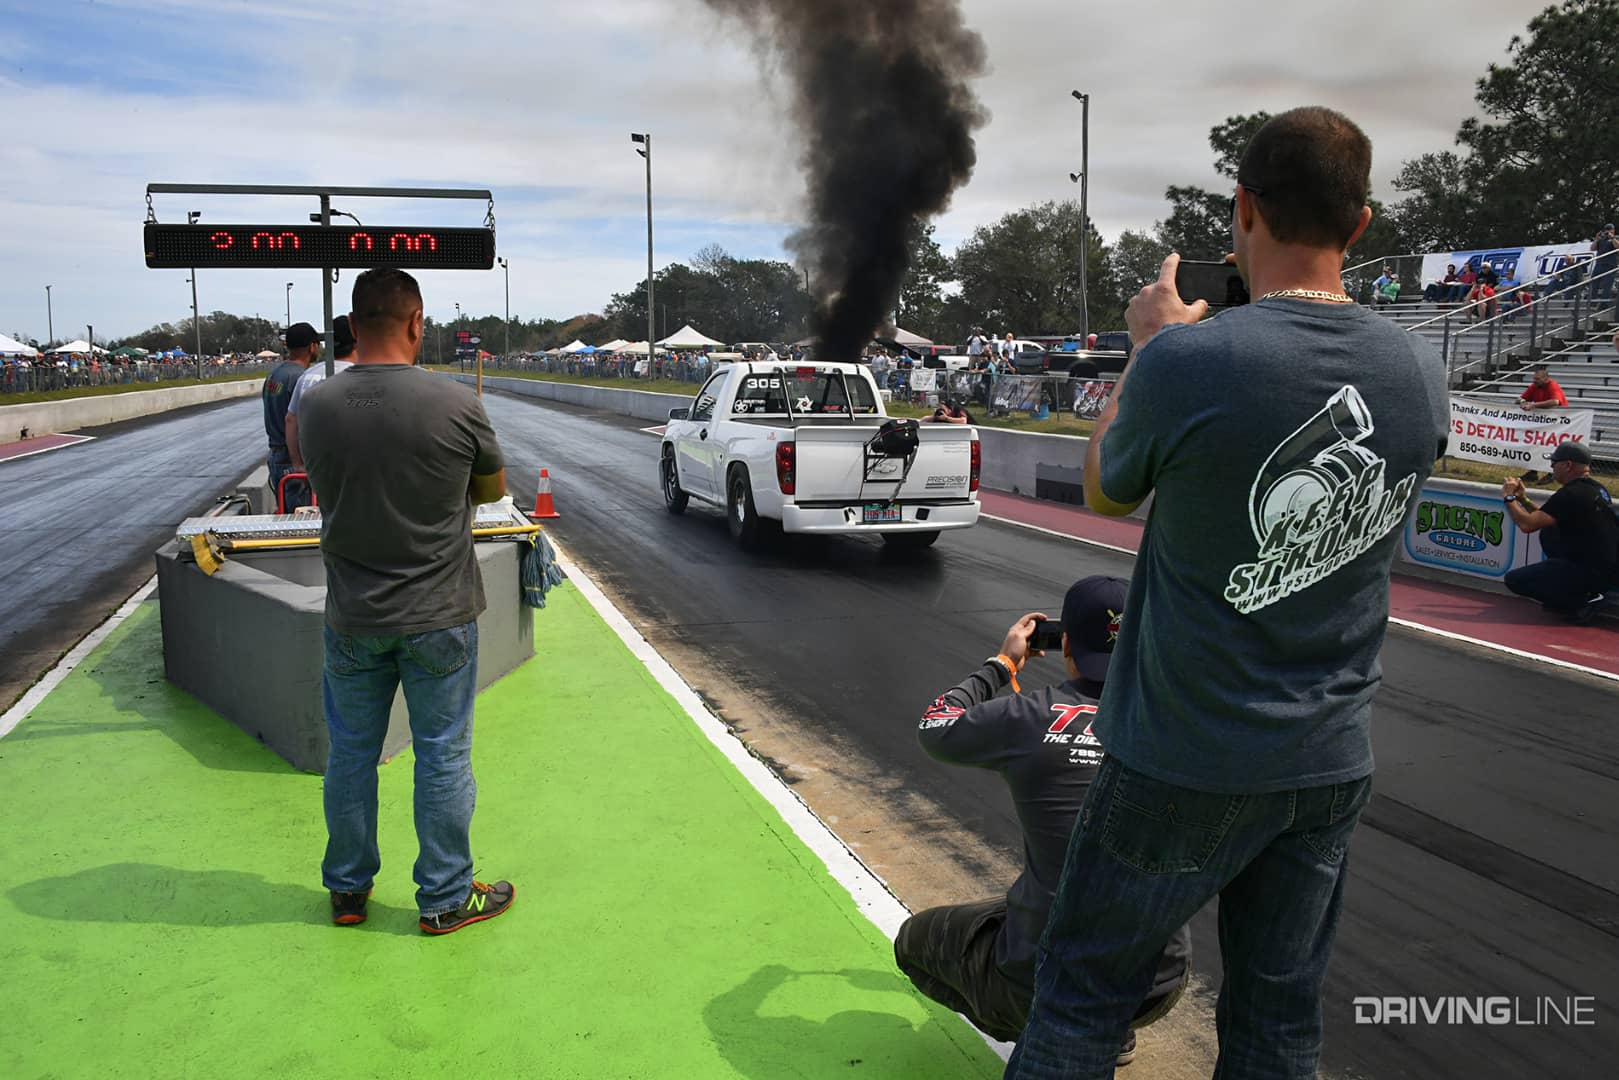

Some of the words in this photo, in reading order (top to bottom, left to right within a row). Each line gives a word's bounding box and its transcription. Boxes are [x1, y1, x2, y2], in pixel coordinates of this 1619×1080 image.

[746, 378, 781, 389] 305
[1452, 403, 1480, 415] Thanks
[1481, 408, 1499, 418] And
[1500, 410, 1557, 424] Appreciation
[1560, 415, 1571, 425] To
[1448, 419, 1464, 434] 'S
[1467, 422, 1519, 443] DETAIL
[1460, 442, 1532, 462] 850-689-AUTO
[1258, 458, 1386, 558] KEEP
[1416, 500, 1504, 546] SIGNS
[1224, 473, 1417, 601] STROKIN
[1435, 534, 1478, 549] GALORE
[1048, 703, 1099, 736] T
[1043, 733, 1073, 743] THE
